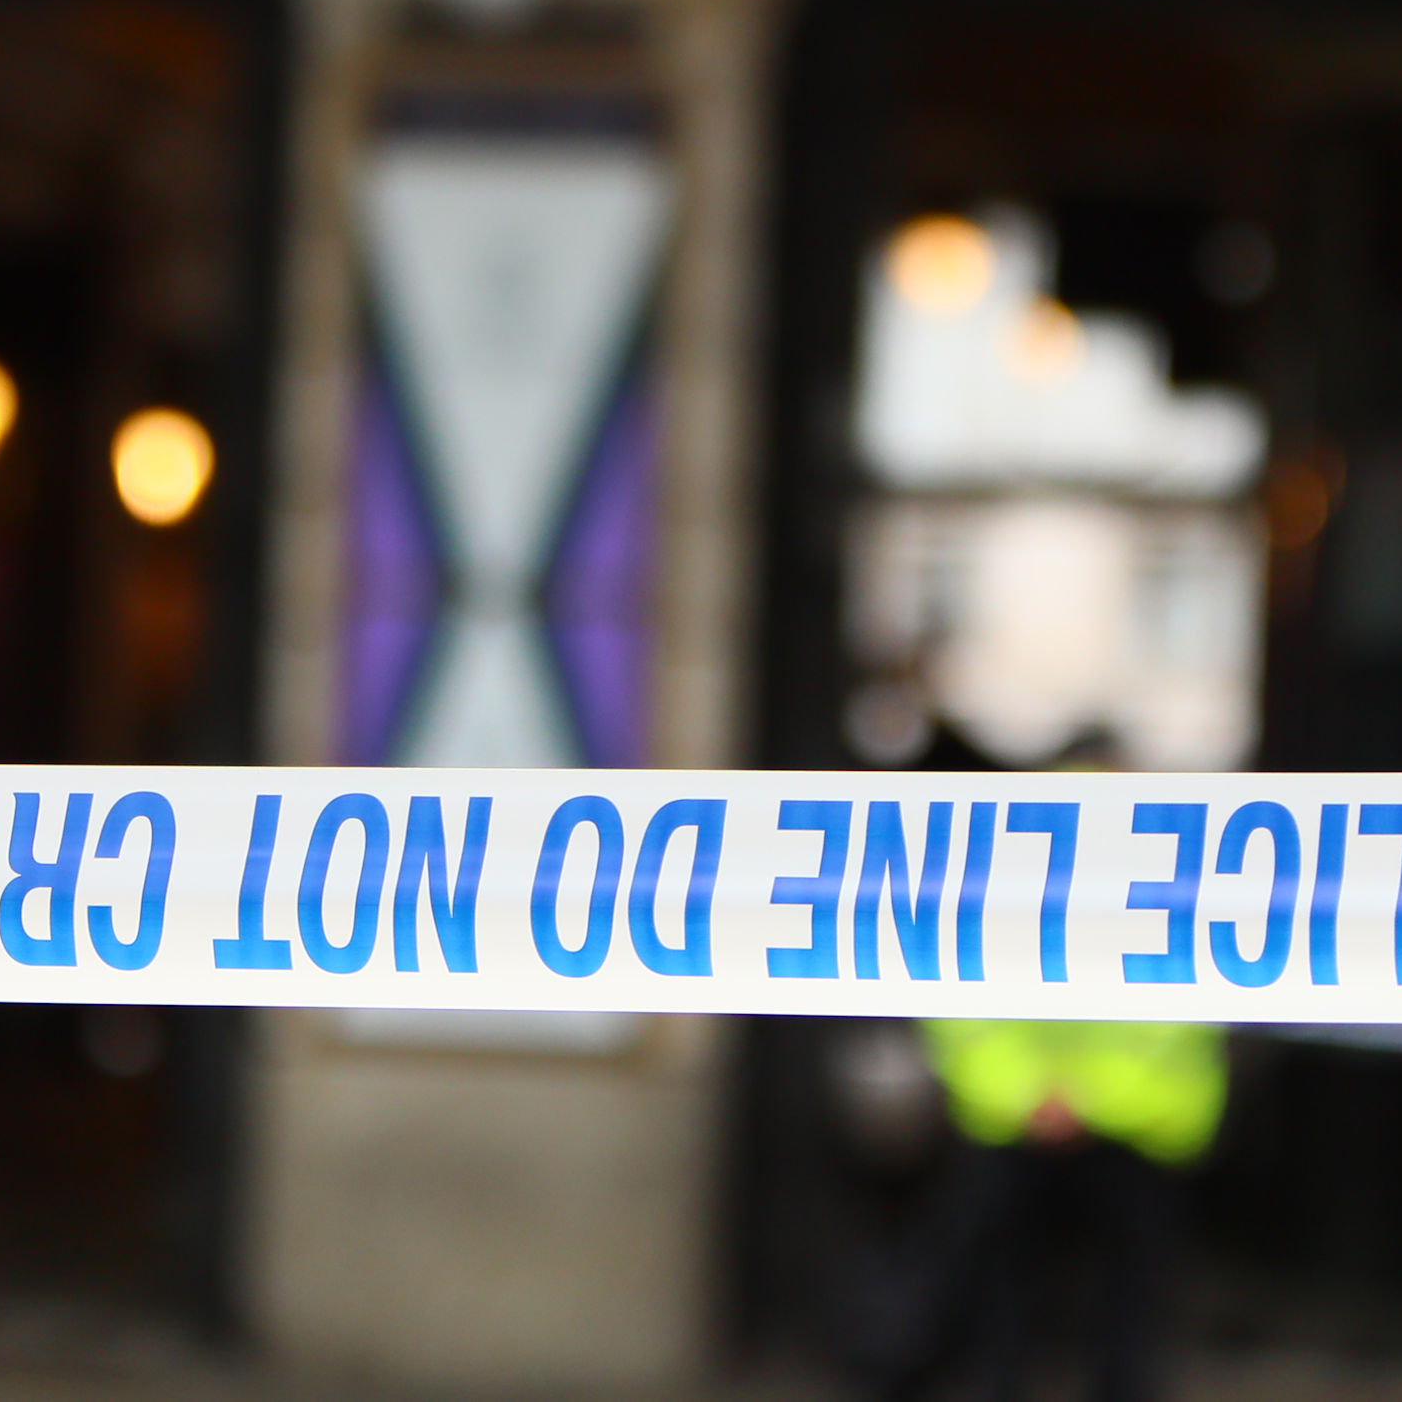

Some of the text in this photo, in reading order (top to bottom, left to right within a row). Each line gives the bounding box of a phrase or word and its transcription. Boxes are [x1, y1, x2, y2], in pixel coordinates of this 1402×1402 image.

[213, 793, 493, 974] NOT
[531, 795, 727, 977] DO
[766, 800, 1081, 982] LINE
